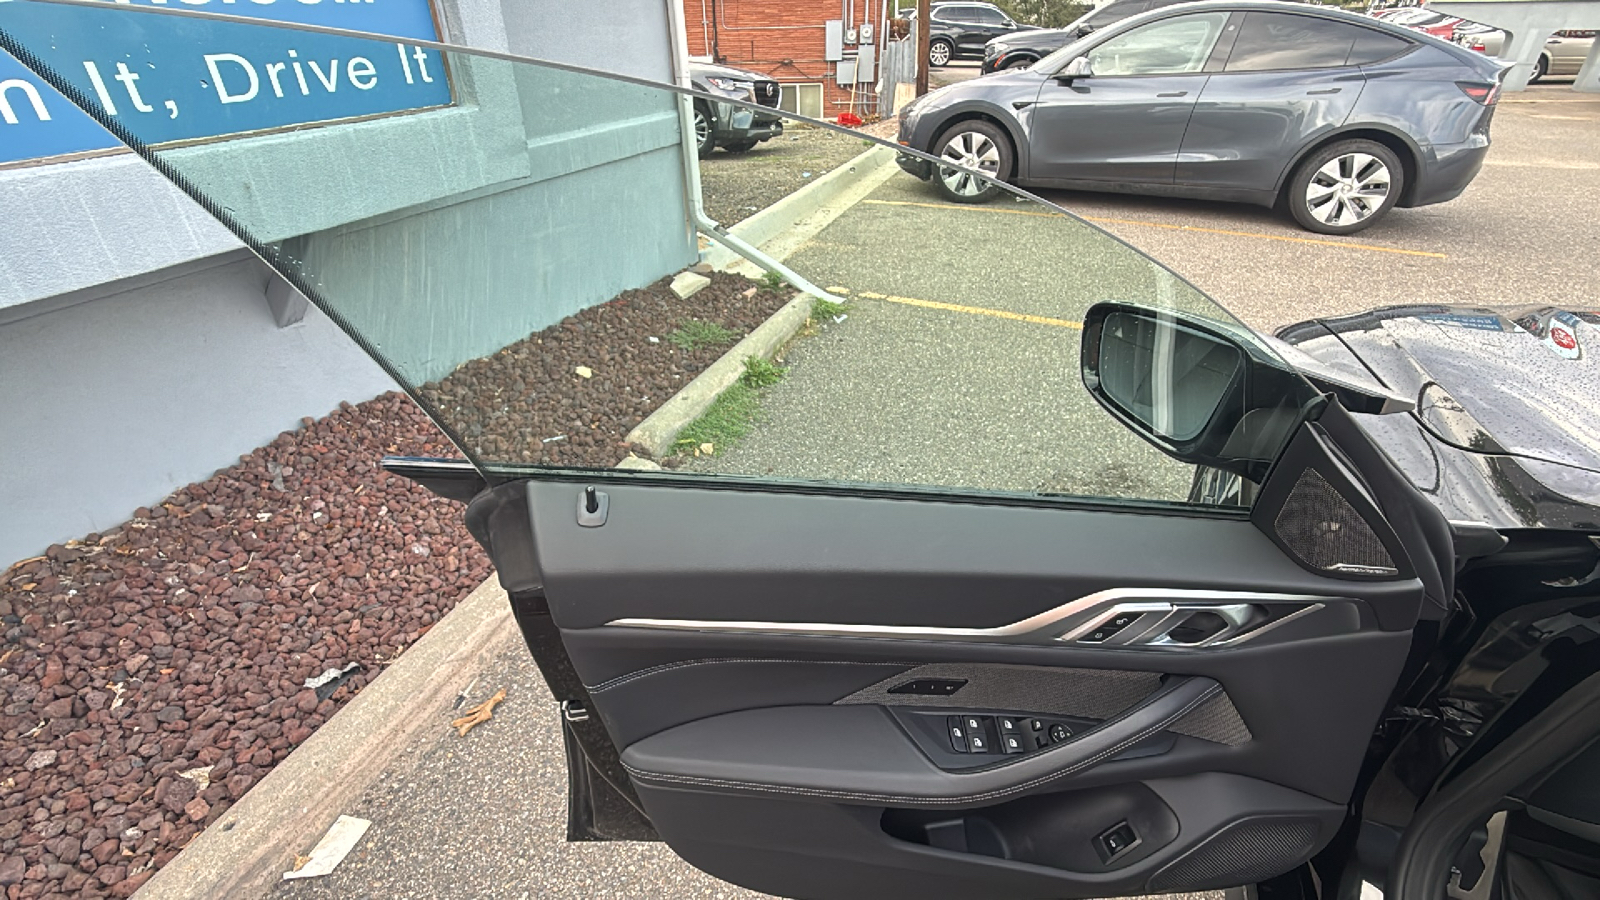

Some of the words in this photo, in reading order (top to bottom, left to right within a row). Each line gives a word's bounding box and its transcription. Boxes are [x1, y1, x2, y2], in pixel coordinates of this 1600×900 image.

[82, 61, 179, 119] It,
[203, 49, 378, 104] Drive
[397, 42, 434, 84] It
